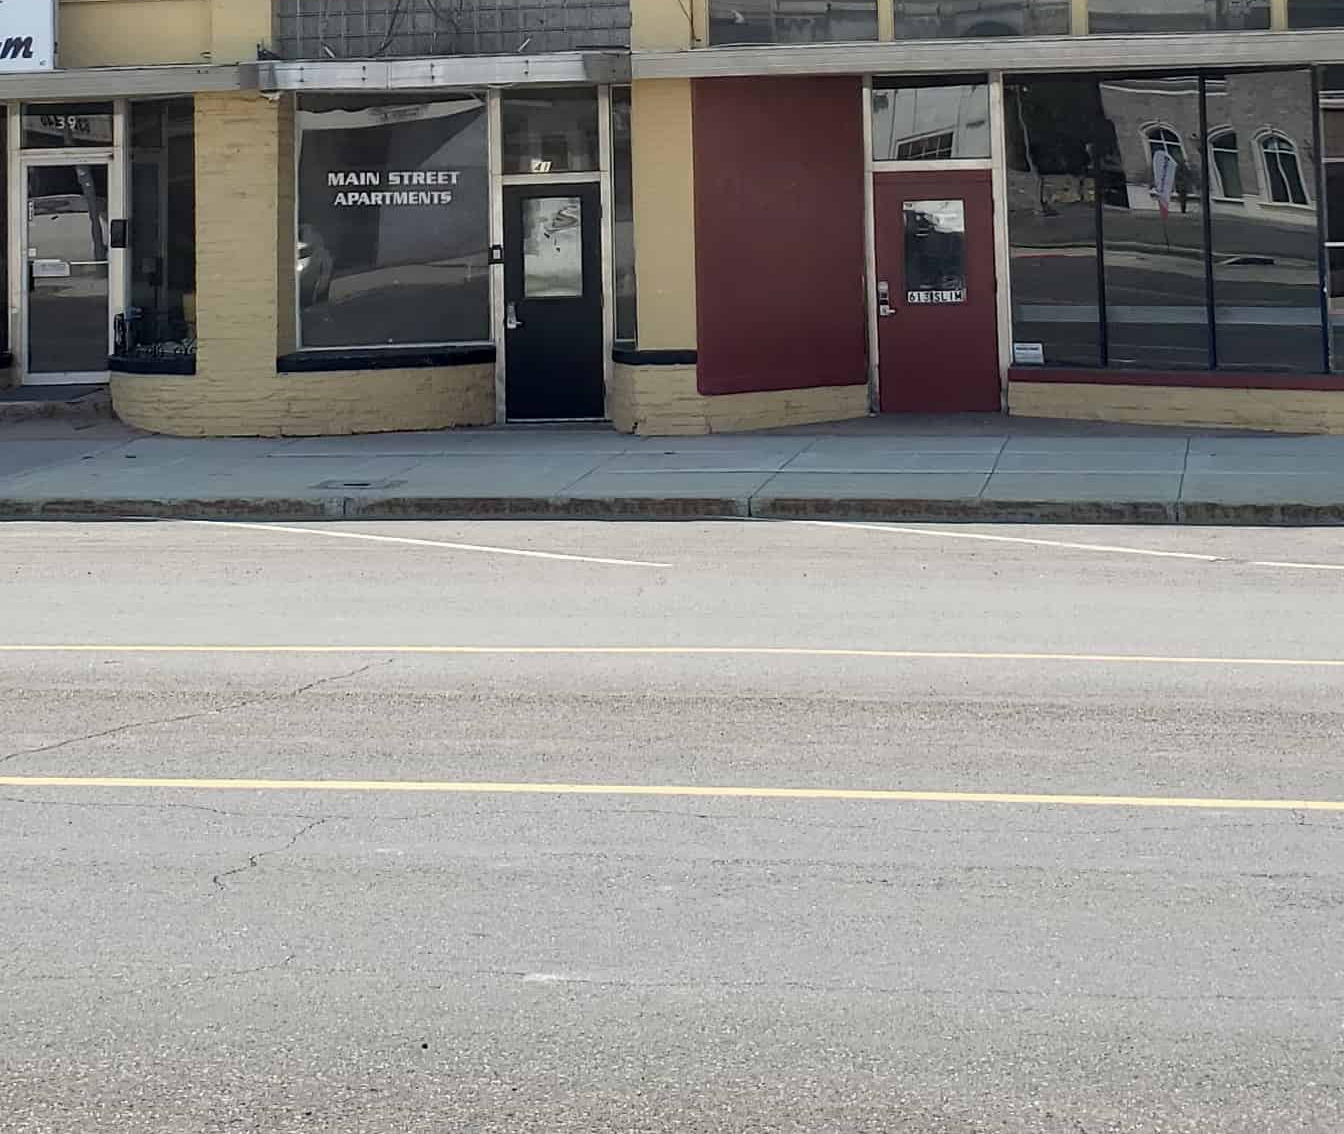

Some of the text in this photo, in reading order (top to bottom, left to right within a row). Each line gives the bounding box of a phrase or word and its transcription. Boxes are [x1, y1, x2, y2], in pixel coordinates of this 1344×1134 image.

[56, 116, 76, 129] 39
[327, 170, 461, 187] MAIN STREET
[333, 190, 452, 206] APARTMENTS
